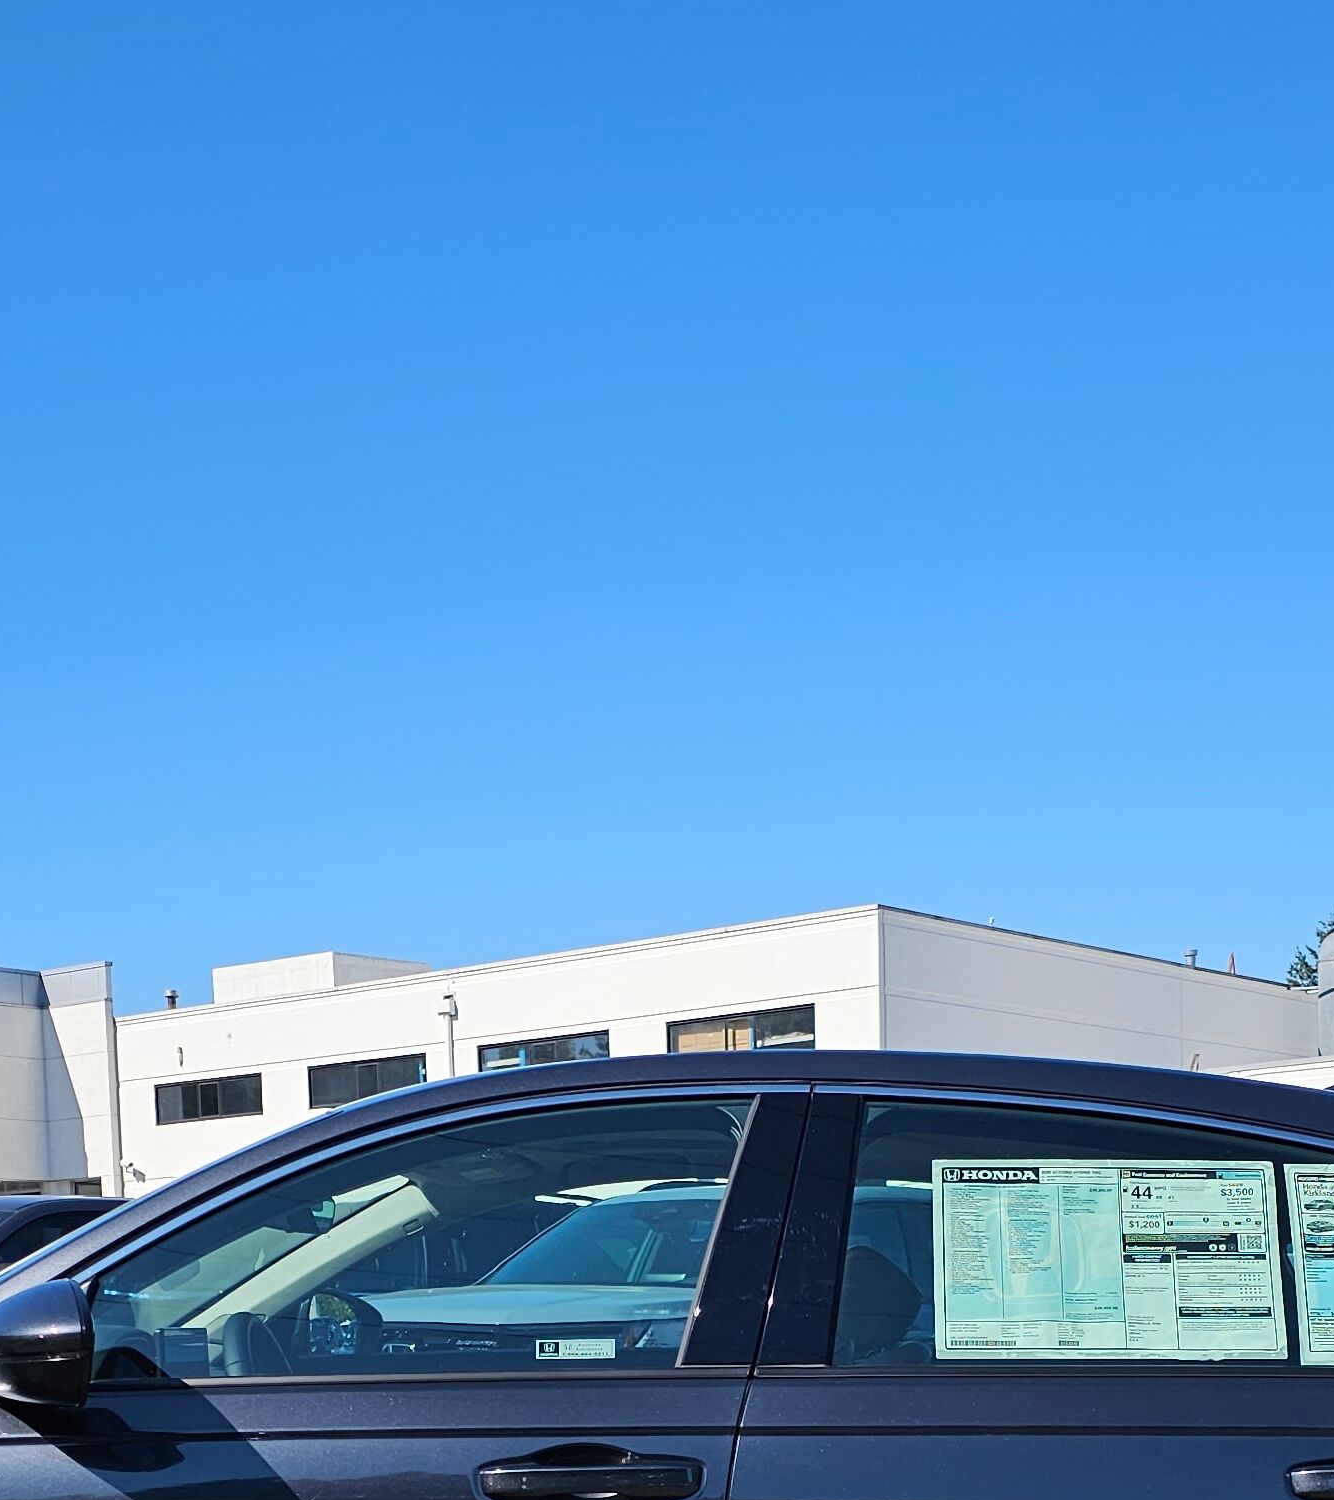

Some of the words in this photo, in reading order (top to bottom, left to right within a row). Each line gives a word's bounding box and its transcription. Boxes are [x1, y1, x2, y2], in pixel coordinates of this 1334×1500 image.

[961, 1170, 1038, 1181] HONDA
[1130, 1185, 1153, 1199] 44
[1220, 1187, 1254, 1198] $3,500
[1128, 1220, 1160, 1230] $1,200
